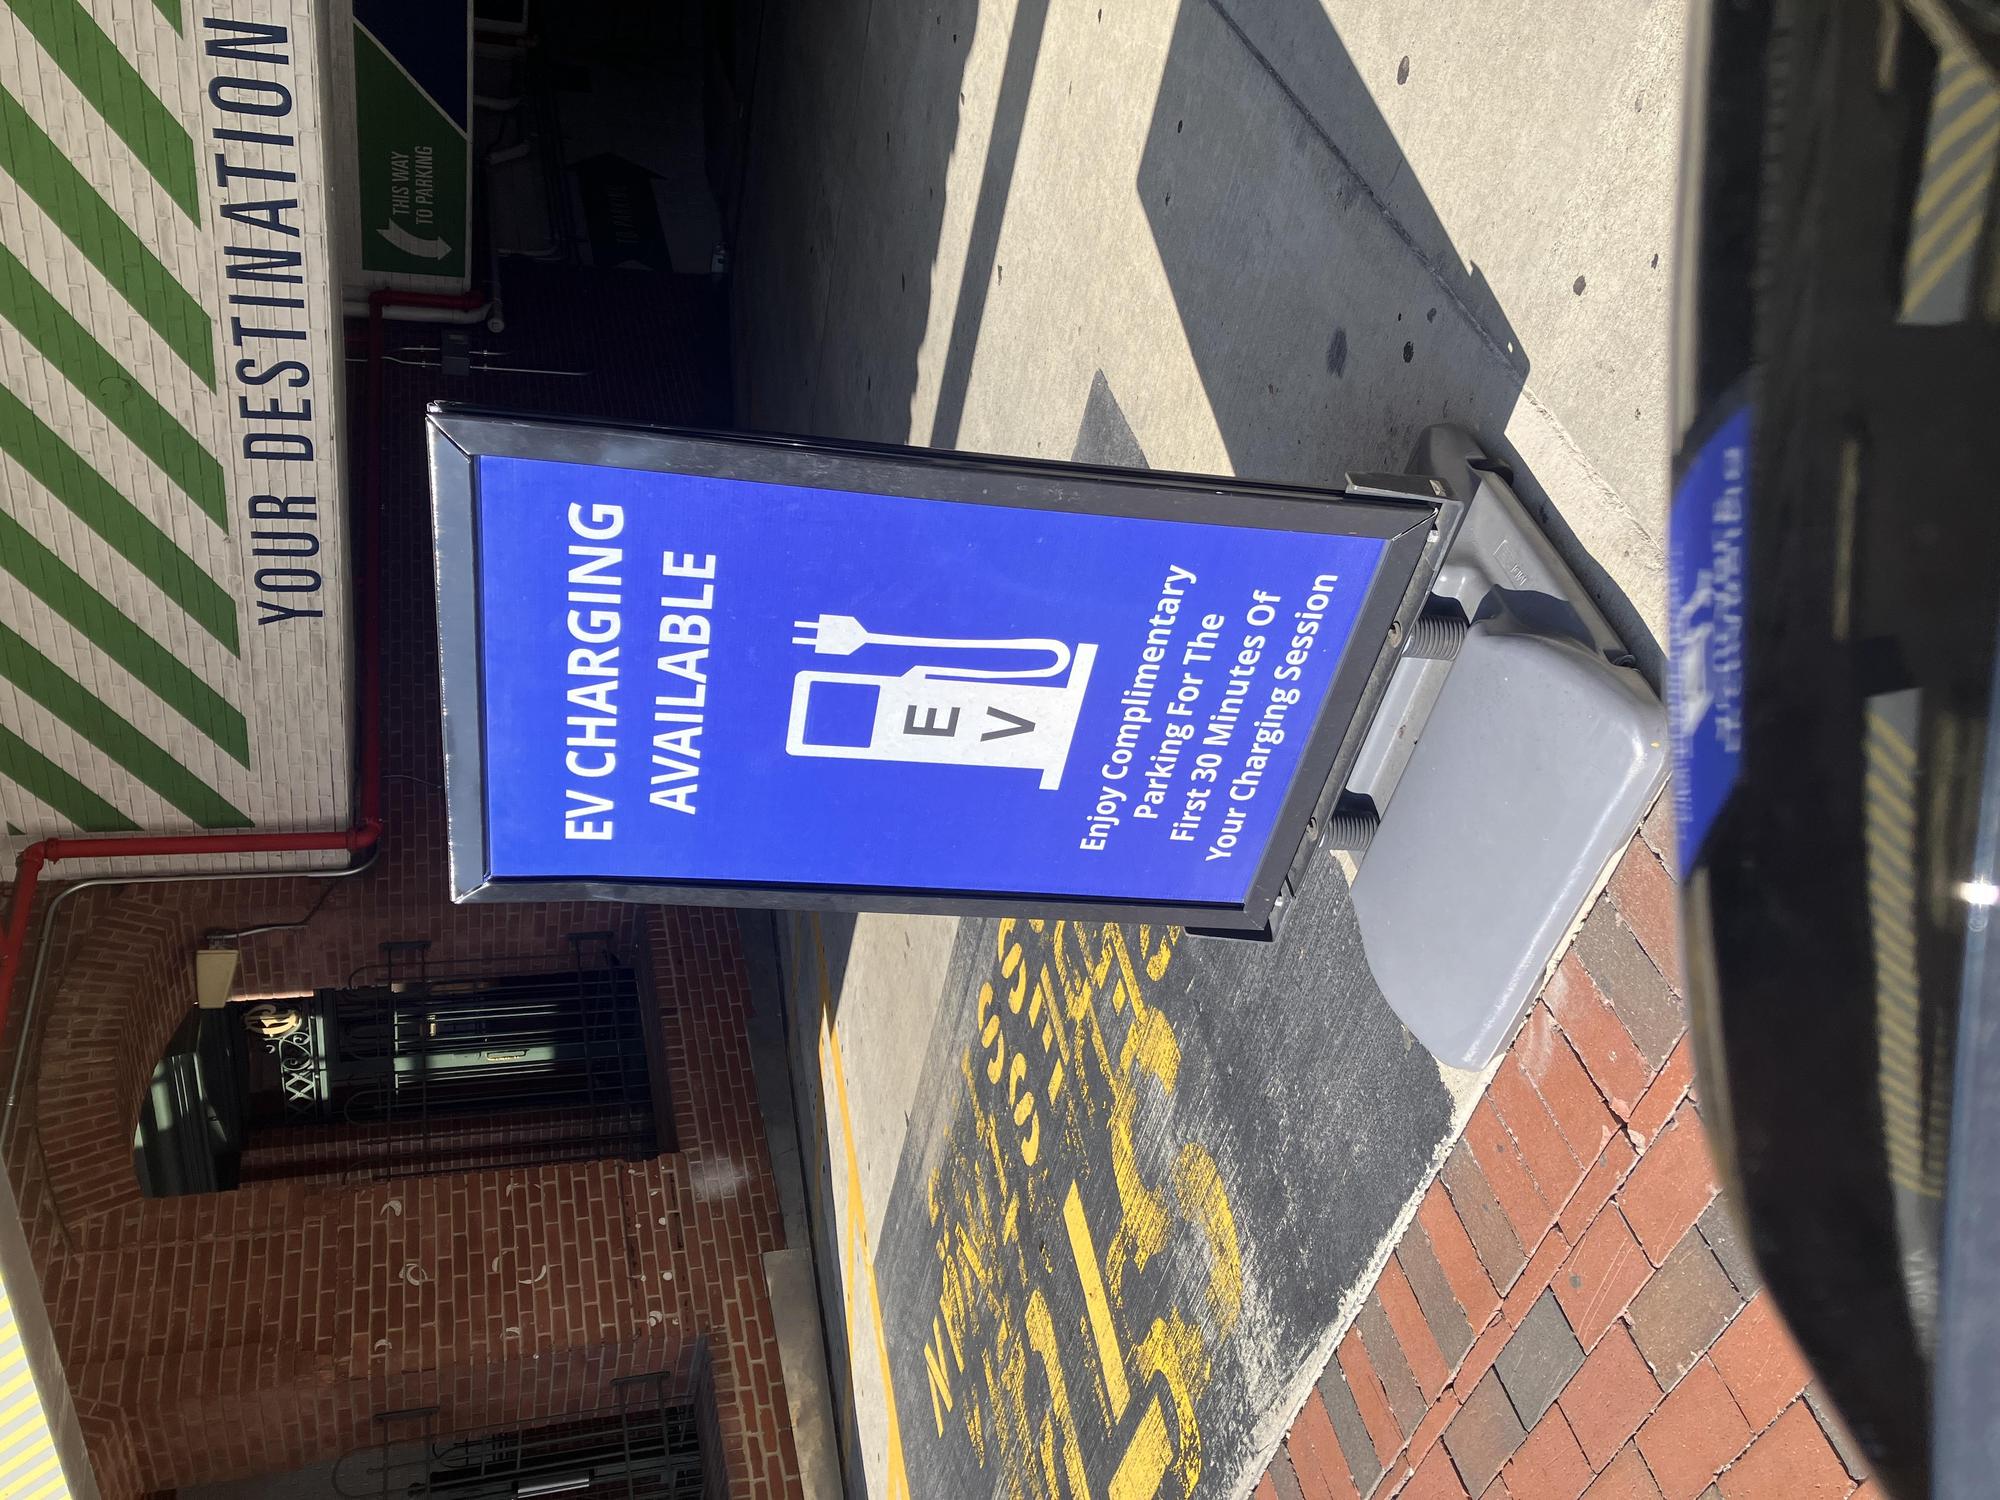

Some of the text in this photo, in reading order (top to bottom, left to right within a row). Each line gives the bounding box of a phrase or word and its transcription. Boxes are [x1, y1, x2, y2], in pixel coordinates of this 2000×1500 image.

[391, 151, 410, 216] THIS WAY
[414, 145, 433, 224] TO PARKING
[203, 17, 323, 627] YOUR DESTINATION
[565, 502, 625, 841] EV CHARGING
[650, 550, 717, 815] AVAILABLE
[1080, 565, 1197, 851] Enjoy Complimentary
[1133, 613, 1225, 819] Parking For The
[1169, 589, 1282, 842] First 30 Minutes Of
[1205, 574, 1339, 862] Your Charging Session
